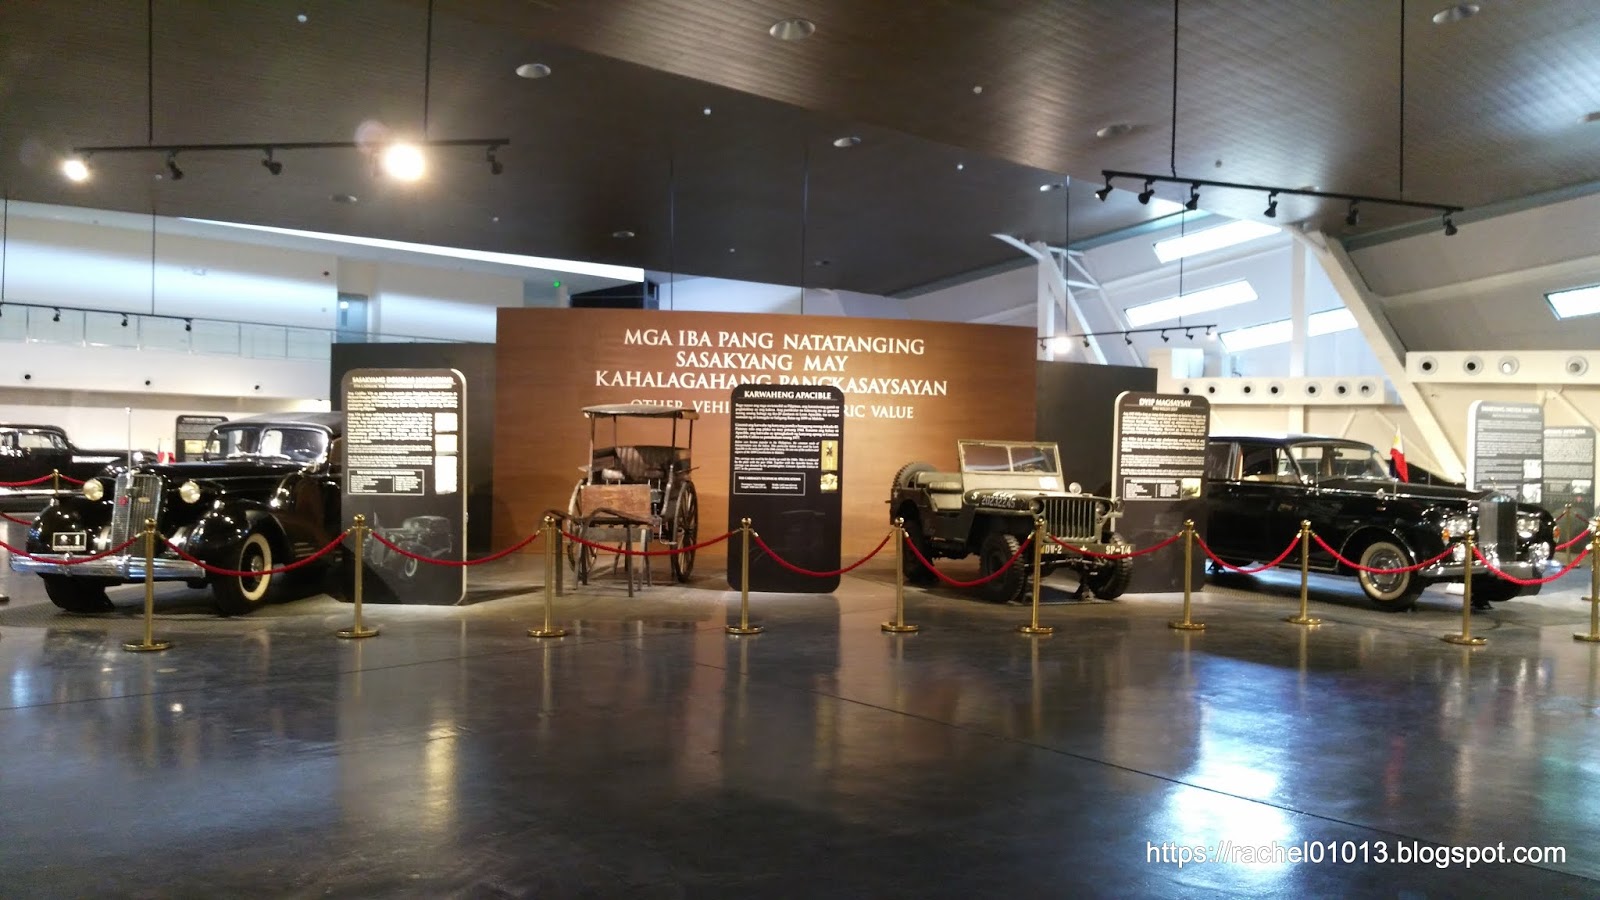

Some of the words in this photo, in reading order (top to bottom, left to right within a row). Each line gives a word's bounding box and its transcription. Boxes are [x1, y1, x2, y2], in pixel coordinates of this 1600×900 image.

[624, 328, 673, 346] MGA
[679, 330, 712, 347] IBA
[718, 331, 774, 349] PANG
[783, 333, 925, 355] NATATANGING
[675, 350, 793, 371] SASAKYANG
[803, 354, 848, 372] MAY
[744, 390, 794, 398] KARWAHENG
[795, 391, 831, 400] APACIBLE
[692, 400, 730, 414] VEHI
[870, 405, 914, 419] VALUE
